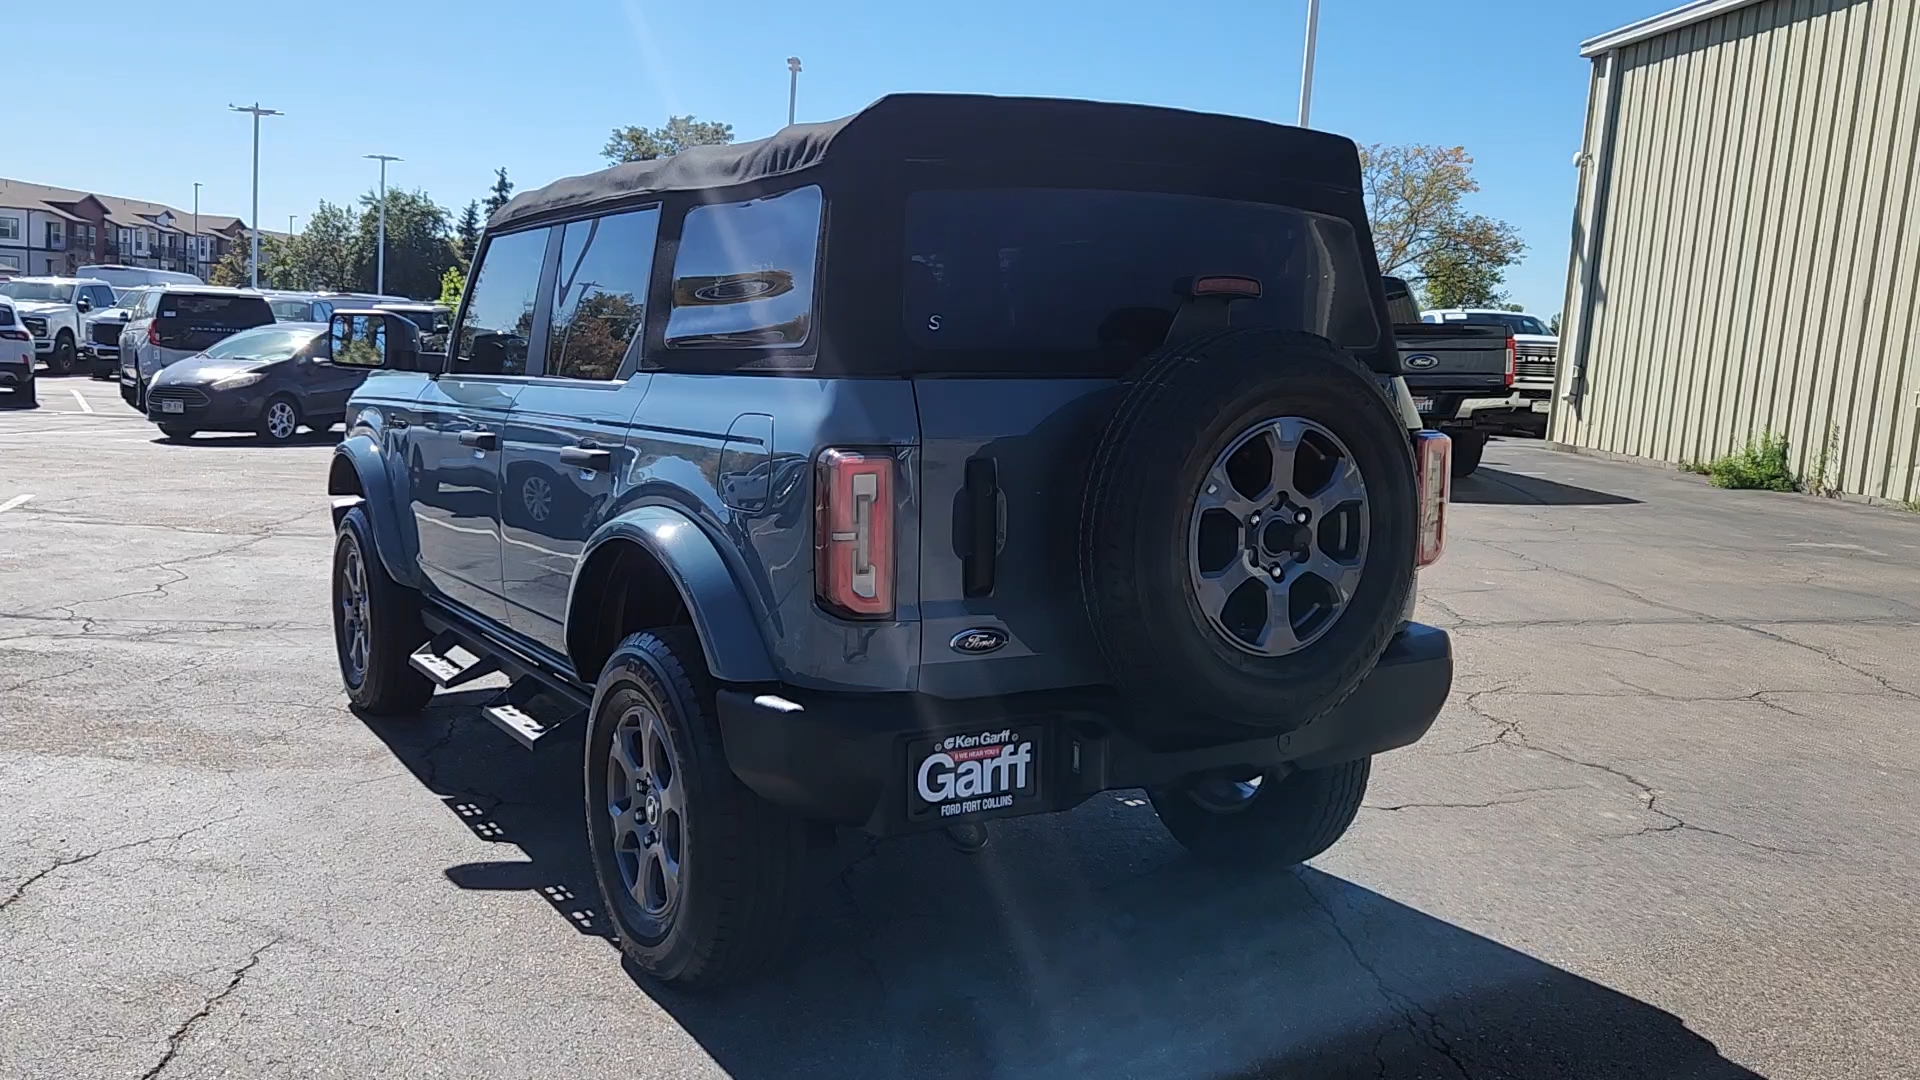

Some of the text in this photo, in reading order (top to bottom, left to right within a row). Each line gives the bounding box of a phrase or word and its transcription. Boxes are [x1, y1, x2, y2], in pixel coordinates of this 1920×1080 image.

[928, 314, 942, 331] S
[1413, 358, 1432, 366] Ford
[1416, 399, 1434, 411] arff
[965, 634, 997, 649] Ford
[955, 729, 1011, 749] Ken Garff
[959, 748, 996, 760] WE HEAR YOU
[917, 742, 1031, 802] Garff
[941, 795, 1013, 817] FORD FORT COLLINS
